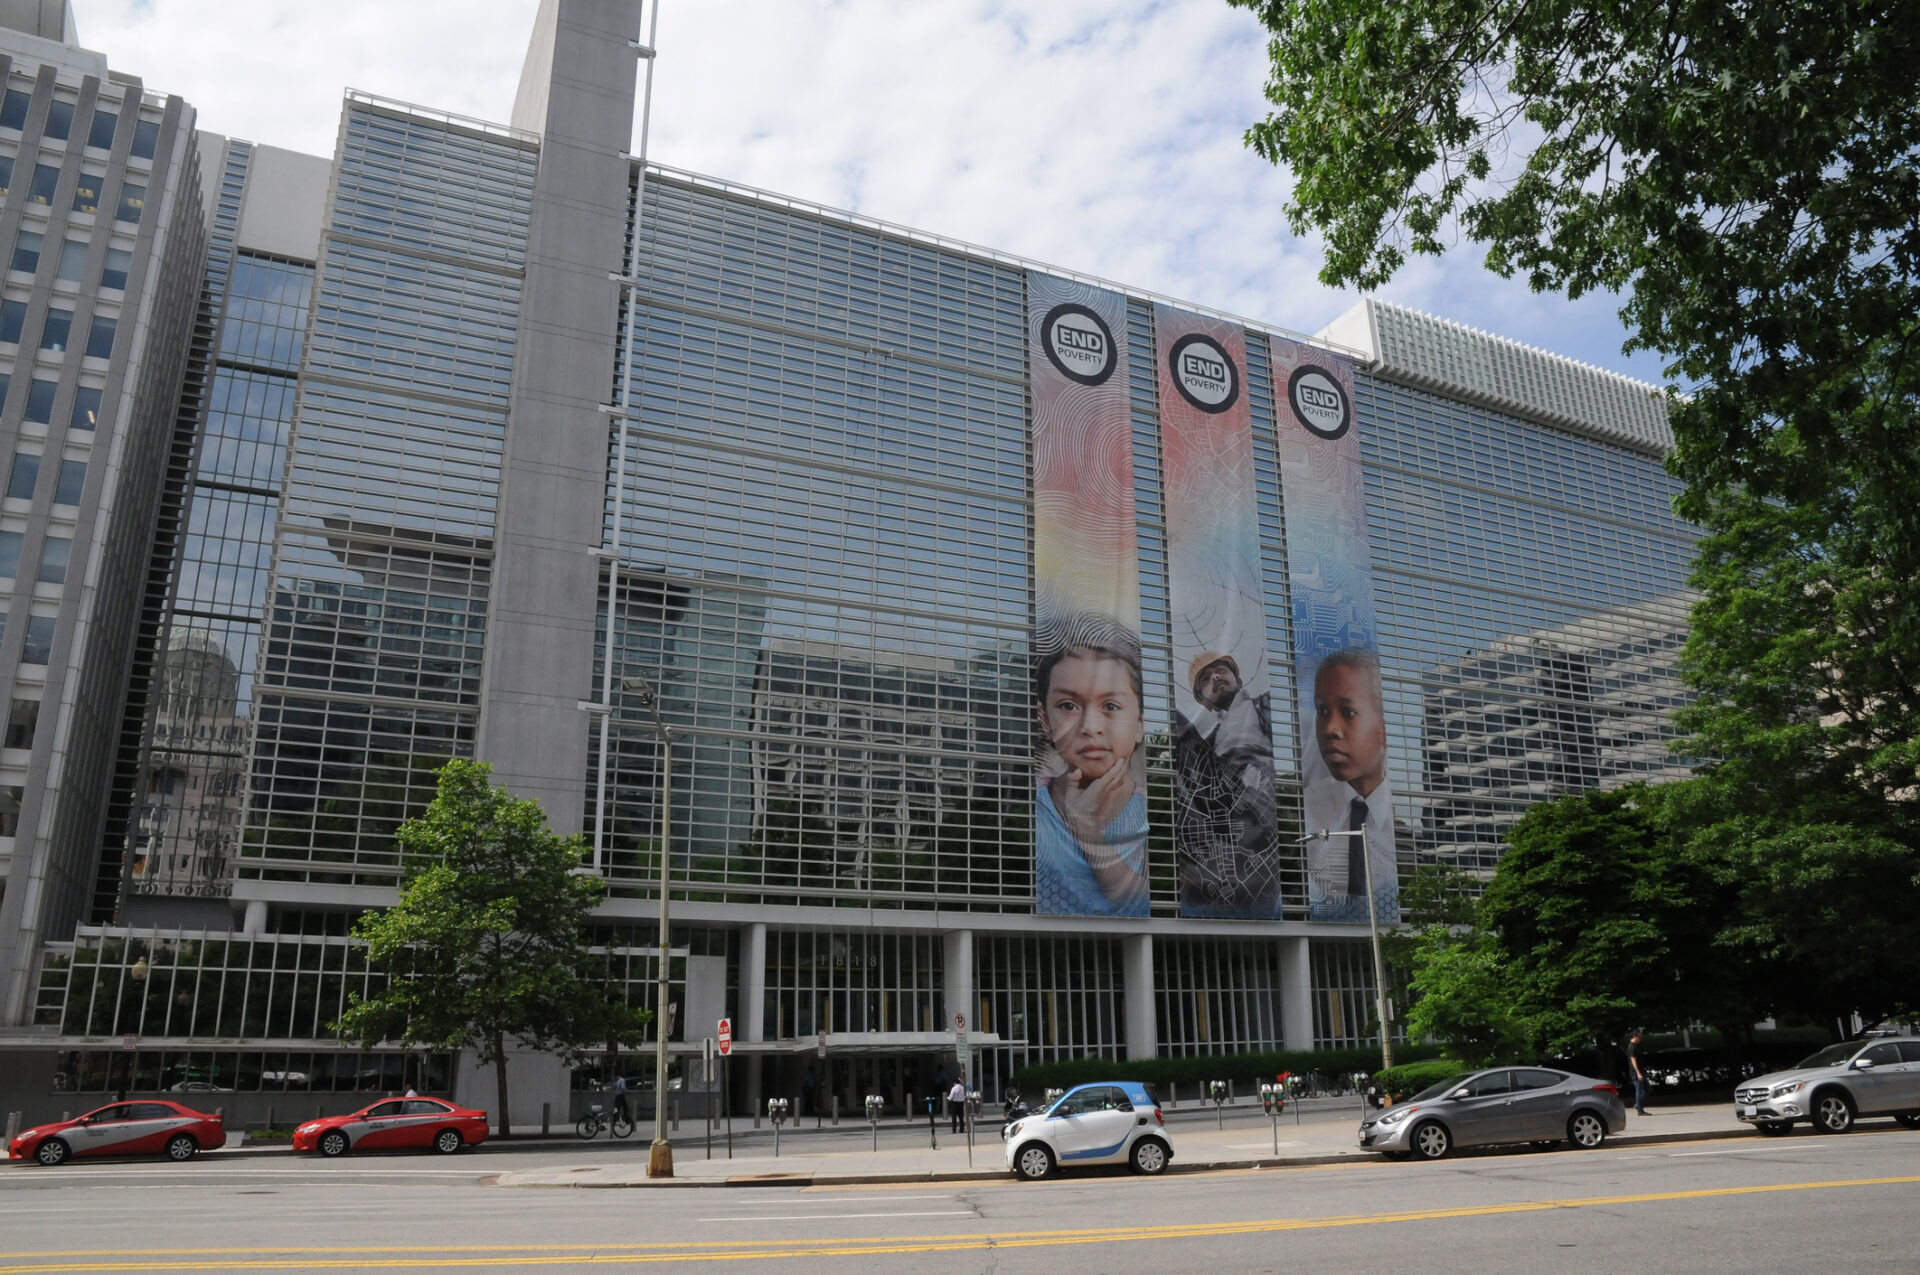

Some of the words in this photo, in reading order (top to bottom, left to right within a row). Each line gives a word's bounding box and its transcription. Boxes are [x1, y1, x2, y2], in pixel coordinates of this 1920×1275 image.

[1058, 325, 1102, 353] END
[1058, 347, 1102, 365] POVERTY
[1184, 355, 1225, 382] END
[1185, 377, 1226, 393] POVERTY
[1301, 386, 1339, 409] END
[1303, 405, 1340, 421] POVERTY
[820, 955, 877, 967] 1818
